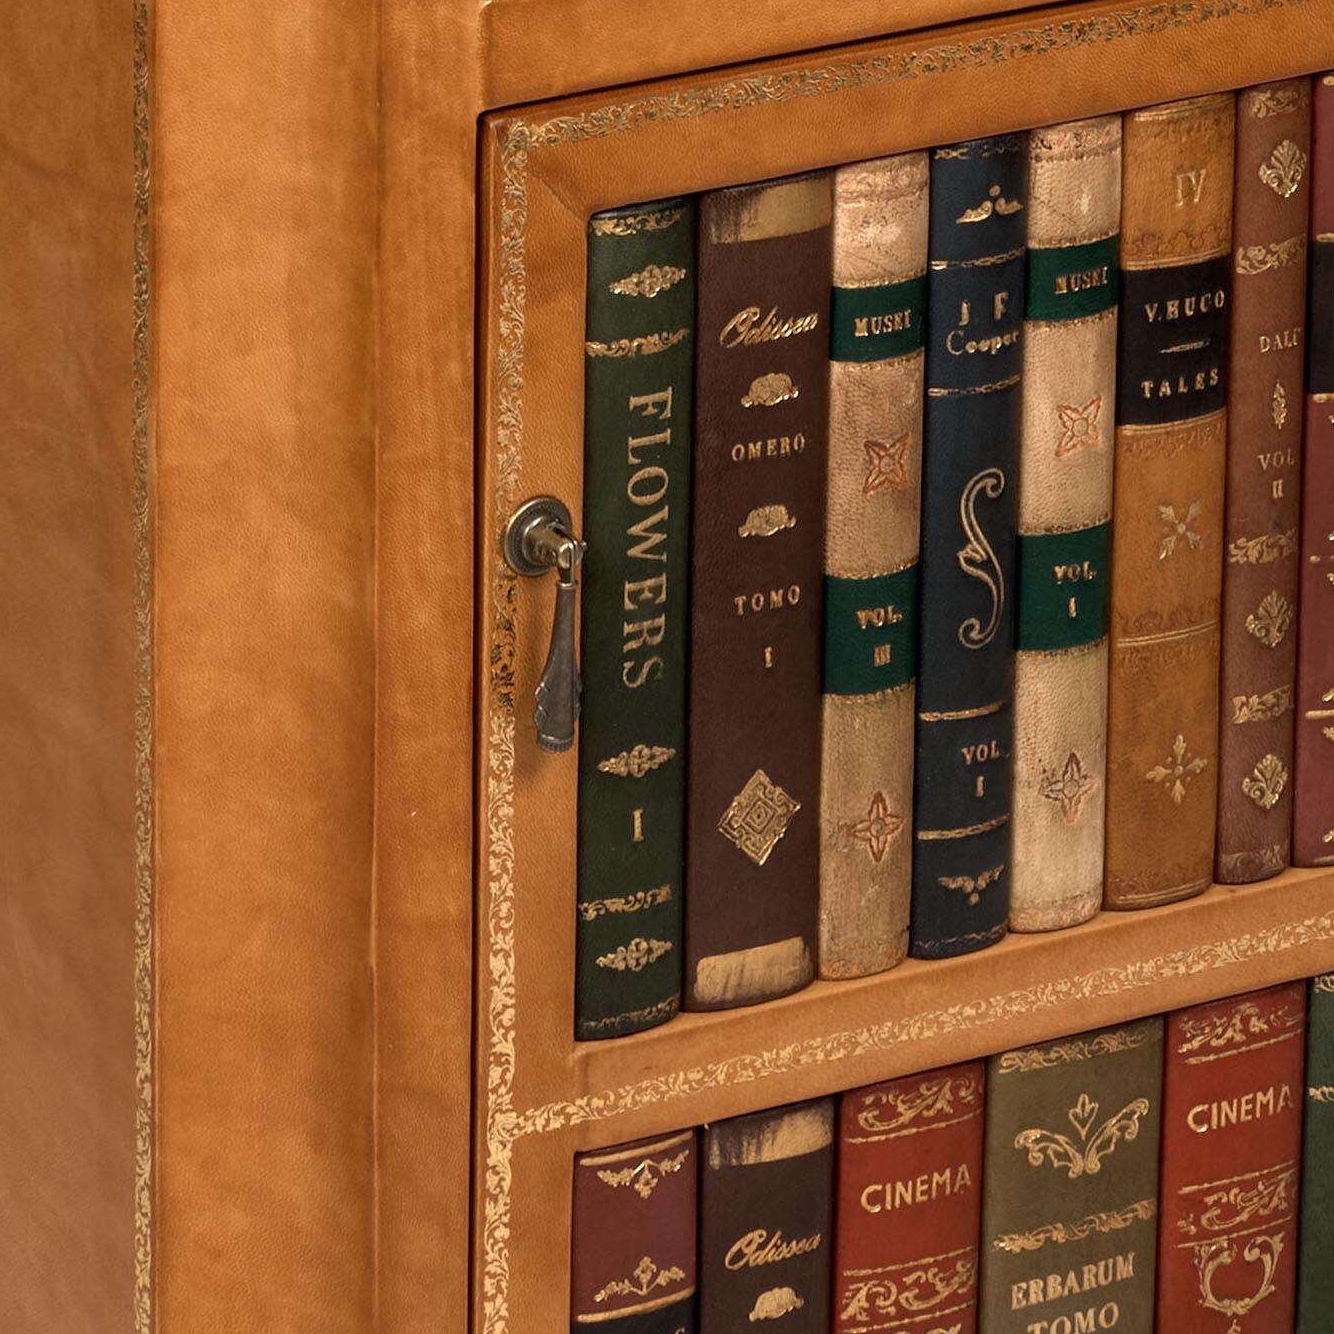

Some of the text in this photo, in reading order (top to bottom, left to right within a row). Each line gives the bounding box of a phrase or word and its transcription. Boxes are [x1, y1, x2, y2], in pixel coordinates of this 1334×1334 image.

[994, 291, 1009, 320] F
[719, 305, 818, 348] Odissea
[946, 330, 1020, 355] Cooper
[1141, 368, 1218, 398] TALES
[731, 433, 805, 461] OMERO
[1272, 479, 1283, 498] II
[621, 386, 674, 690] FLOWERS
[734, 585, 801, 615] TOMO
[1069, 597, 1076, 617] I
[764, 646, 773, 668] I
[976, 776, 984, 797] I
[631, 809, 643, 842] I
[1187, 1082, 1295, 1134] CINEMA
[861, 1162, 972, 1214] CINEMA
[724, 1228, 822, 1270] Odissea
[1010, 1251, 1136, 1311] ERBARUM
